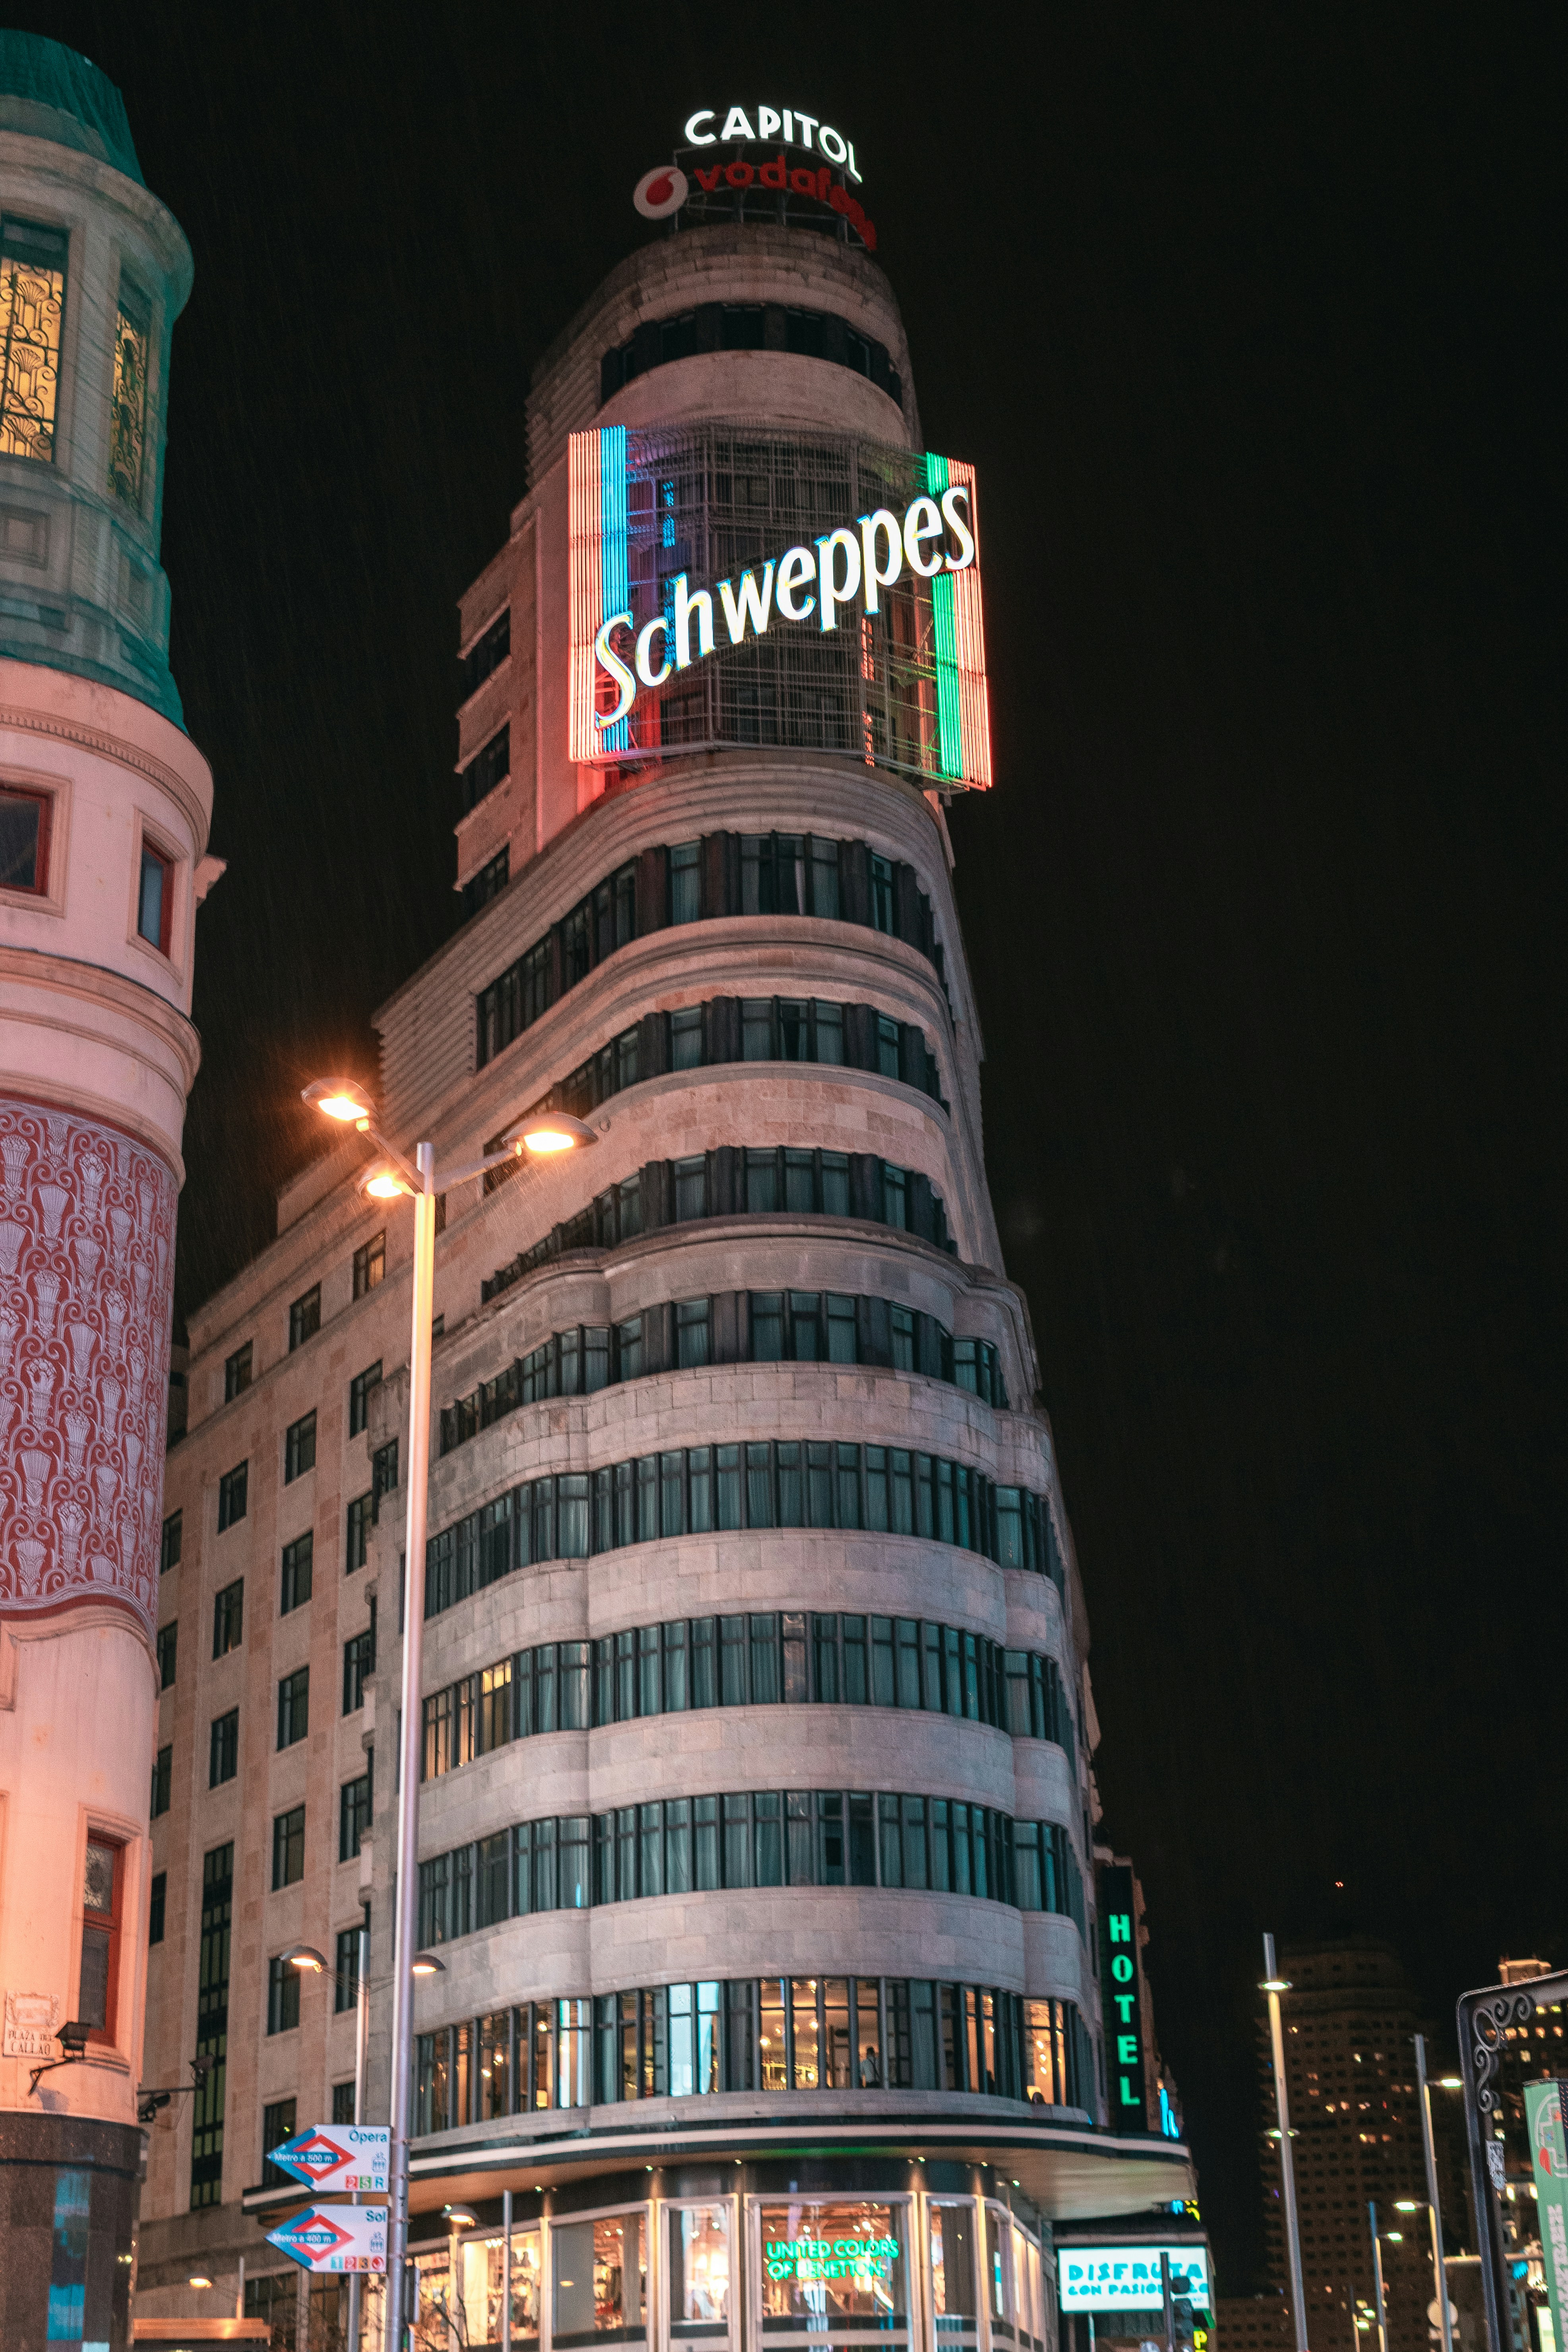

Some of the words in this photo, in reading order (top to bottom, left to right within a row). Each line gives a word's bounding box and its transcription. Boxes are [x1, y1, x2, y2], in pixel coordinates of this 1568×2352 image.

[685, 106, 862, 182] CAPITOL
[595, 486, 975, 728] Schweppes
[1109, 1914, 1140, 2105] HOTEL
[9, 2030, 35, 2041] PLAZA
[11, 2040, 50, 2056] CALLAO
[274, 2152, 298, 2162] Metro
[366, 2209, 386, 2222] Sol
[273, 2233, 297, 2242] Metro
[766, 2240, 832, 2260] UNITED
[833, 2239, 899, 2259] COLORS
[767, 2260, 794, 2280] OF
[1068, 2285, 1102, 2296] CON
